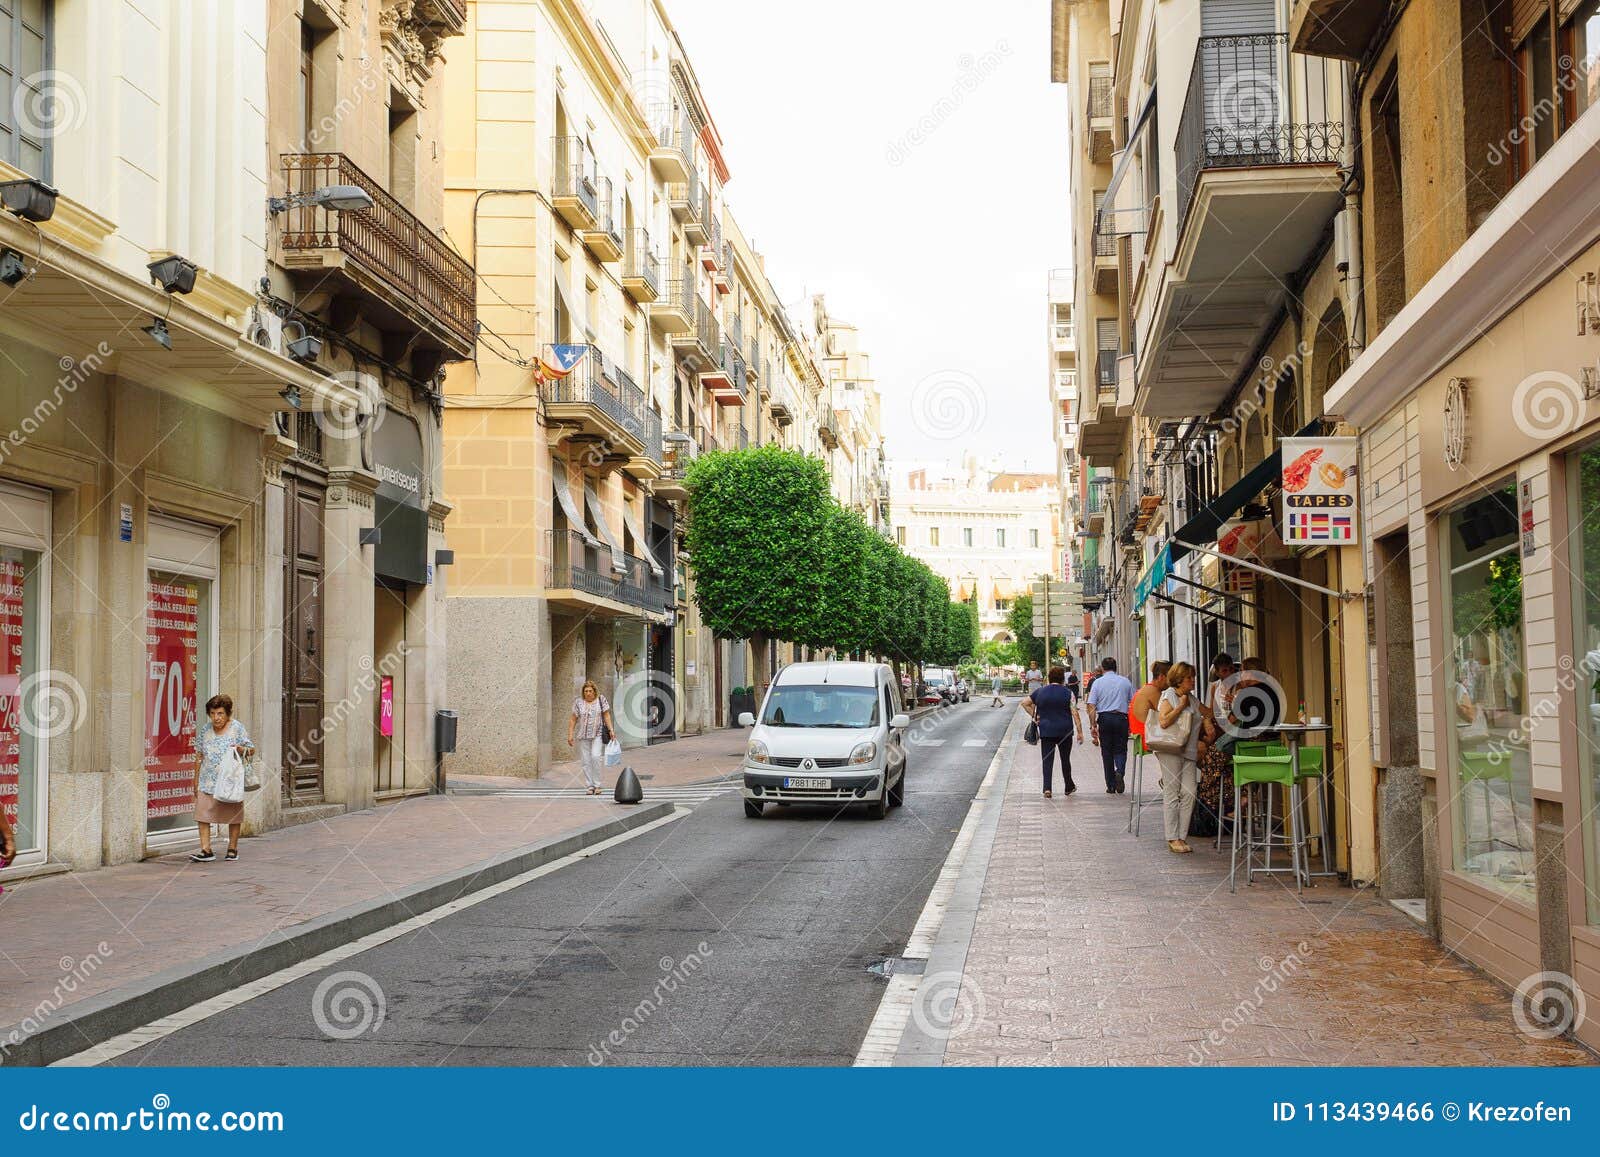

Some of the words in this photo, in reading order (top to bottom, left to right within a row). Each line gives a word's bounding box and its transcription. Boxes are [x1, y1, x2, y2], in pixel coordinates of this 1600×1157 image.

[1292, 495, 1347, 506] TAPES
[0, 563, 24, 577] BAJAS
[0, 603, 23, 616] BAJAS
[382, 699, 392, 717] 70
